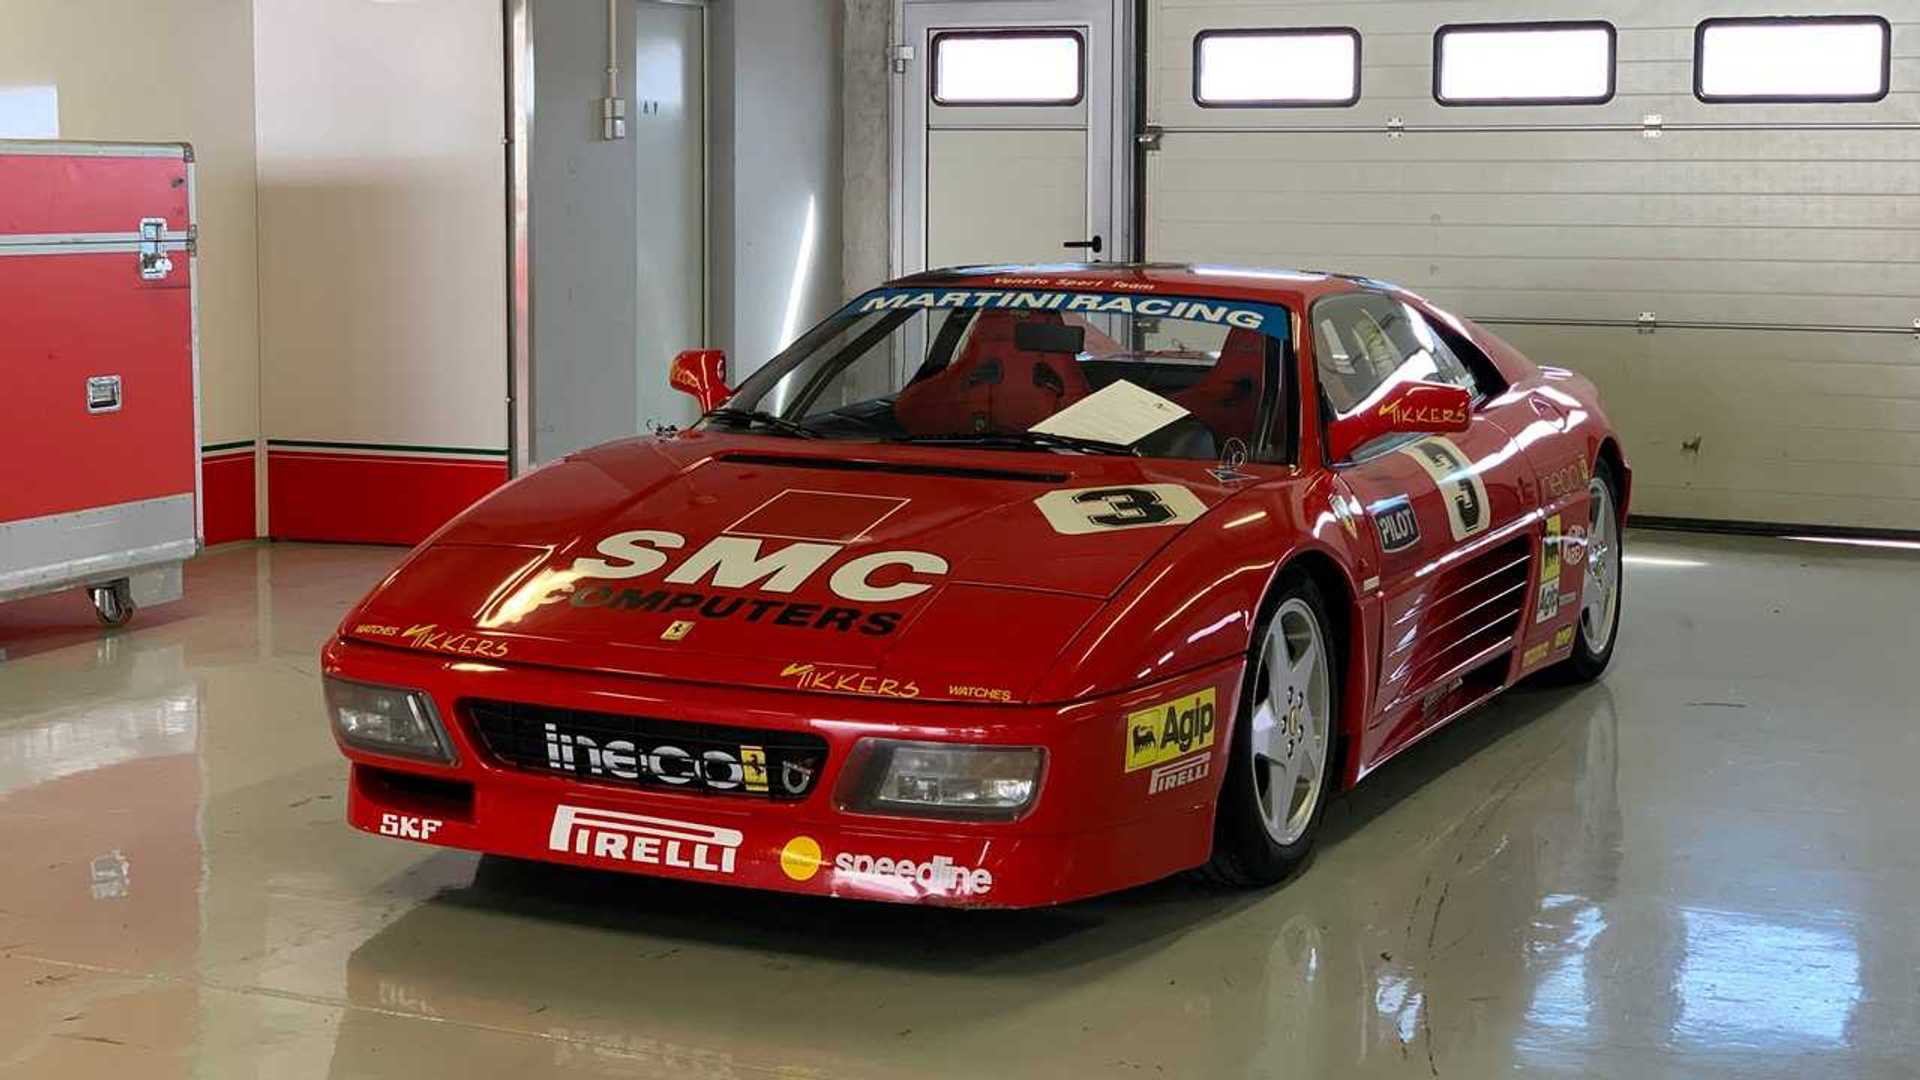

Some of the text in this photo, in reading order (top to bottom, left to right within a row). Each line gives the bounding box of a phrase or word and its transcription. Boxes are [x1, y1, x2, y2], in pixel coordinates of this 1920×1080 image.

[993, 277, 1155, 291] Veneto Sport Team
[862, 292, 1264, 330] MARTINI RACING
[1071, 488, 1177, 526] 3
[1414, 441, 1480, 532] 3
[1378, 509, 1417, 545] PILOT
[573, 529, 949, 602] SMC
[948, 684, 1012, 701] WATCHES
[1160, 696, 1214, 752] Agip
[544, 722, 743, 789] ineco
[1148, 751, 1212, 795] PIRELLI
[380, 813, 443, 840] SKF
[549, 804, 743, 873] PIRELLI
[834, 851, 993, 895] speedline
